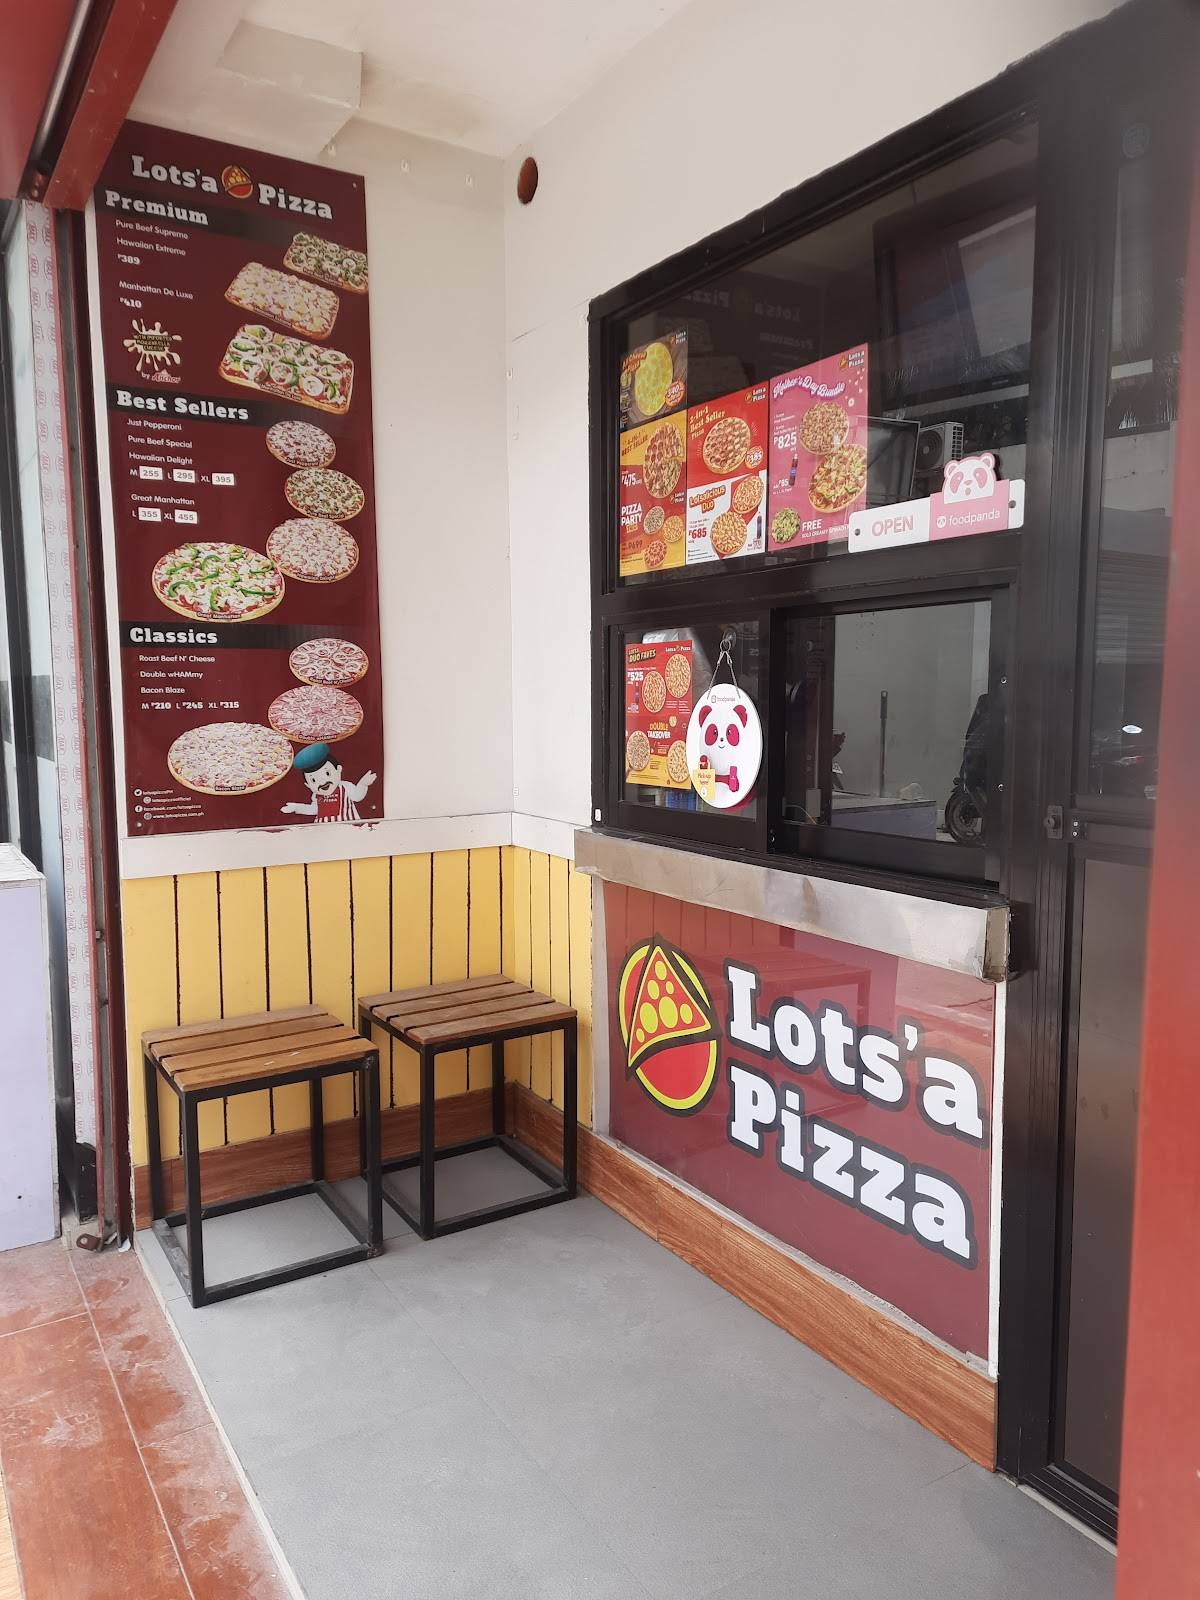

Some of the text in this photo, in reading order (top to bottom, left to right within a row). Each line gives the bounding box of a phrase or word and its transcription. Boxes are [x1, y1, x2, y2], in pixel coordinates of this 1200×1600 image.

[132, 154, 332, 220] Lots'a Pizza
[105, 190, 208, 225] Premium
[116, 220, 188, 240] Pure Beef Supreme
[116, 238, 186, 256] Hawaiian Extreme
[119, 280, 194, 300] Manhattan De Luxe
[141, 372, 151, 382] by
[116, 391, 249, 420] Best Sellers
[126, 418, 182, 432] Just Pepperoni
[128, 436, 193, 450] Pure Beef Special
[128, 452, 193, 467] Hawaiian Delight
[130, 469, 138, 477] M
[143, 470, 160, 478] 255
[176, 472, 193, 480] 295
[200, 475, 210, 483] XL
[131, 494, 195, 506] Great Manhattan
[142, 510, 158, 518] 355
[164, 512, 174, 520] XL
[178, 513, 194, 522] 455
[622, 503, 642, 516] PIZZA
[948, 508, 1001, 526] foodpanda
[622, 512, 643, 527] PARTY
[802, 518, 823, 532] FREE
[871, 514, 914, 538] OPEN
[130, 627, 218, 644] Classics
[139, 654, 160, 662] Roast
[161, 654, 178, 662] Beef
[188, 655, 216, 663] Cheese
[140, 670, 204, 680] Double wHAMmy
[140, 686, 186, 694] Bacon Blaze
[728, 965, 982, 1138] Lots'a
[730, 1065, 970, 1259] Pizza
